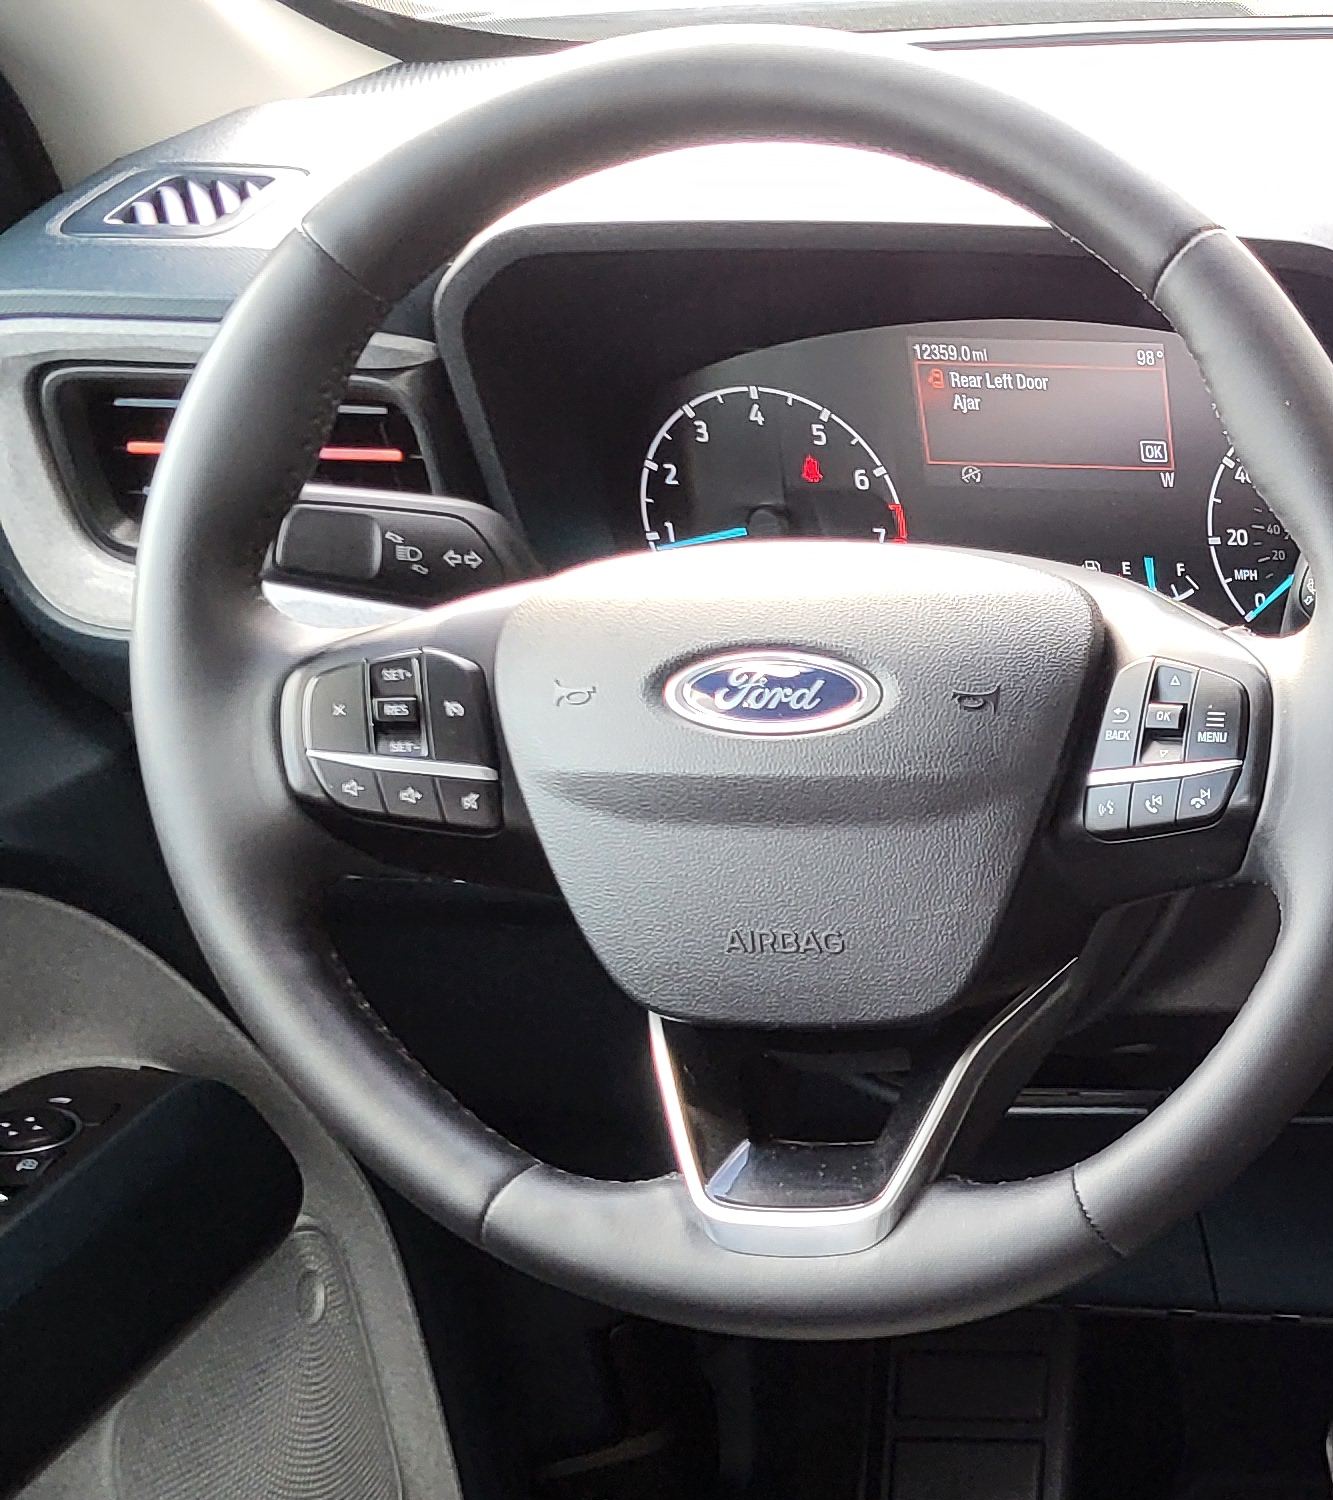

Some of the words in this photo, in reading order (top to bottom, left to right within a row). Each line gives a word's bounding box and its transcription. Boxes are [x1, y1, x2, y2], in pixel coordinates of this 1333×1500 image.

[913, 344, 970, 361] 12359.0
[949, 371, 983, 389] Rear
[985, 372, 1014, 390] Left
[1016, 373, 1049, 391] Door
[953, 394, 981, 413] Ajar
[749, 403, 765, 426] 4
[693, 419, 710, 443] 3
[811, 424, 827, 445] 5
[1145, 444, 1164, 459] OK
[662, 463, 680, 485] 2
[854, 469, 870, 490] 6
[1226, 529, 1249, 546] 20
[1266, 524, 1281, 535] 40
[1271, 550, 1286, 561] 20
[1121, 561, 1132, 575] E
[1176, 563, 1186, 577] F
[1234, 569, 1258, 581] MPH
[714, 666, 825, 711] Ford
[1156, 711, 1171, 722] OK
[1105, 730, 1131, 741] BACK
[1197, 731, 1228, 743] MENU
[725, 929, 846, 955] AIRBAG
